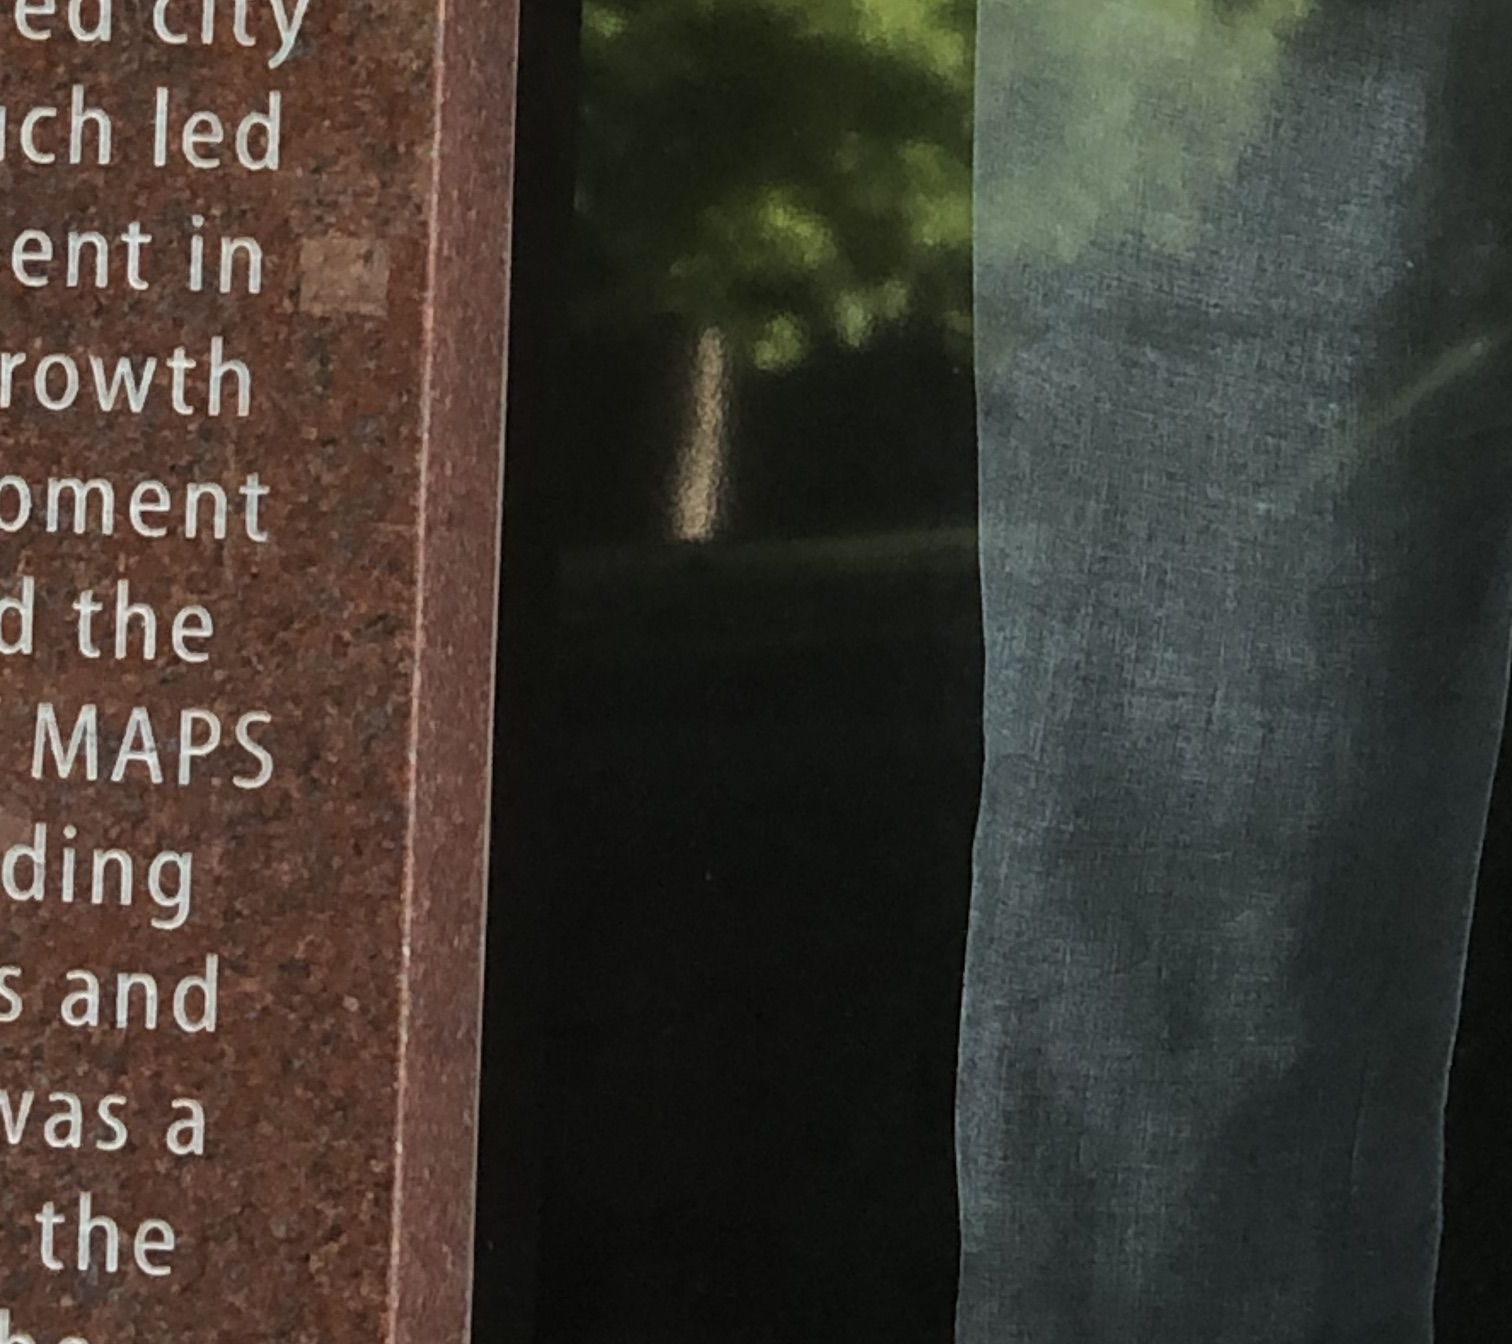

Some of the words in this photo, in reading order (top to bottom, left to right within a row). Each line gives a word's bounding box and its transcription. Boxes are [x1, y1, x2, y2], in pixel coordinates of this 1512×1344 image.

[153, 87, 281, 171] led
[188, 215, 263, 294] in
[72, 580, 213, 663] the
[31, 703, 273, 790] MAPS
[60, 955, 218, 1034] and
[166, 1099, 205, 1156] a
[35, 1192, 176, 1277] the
